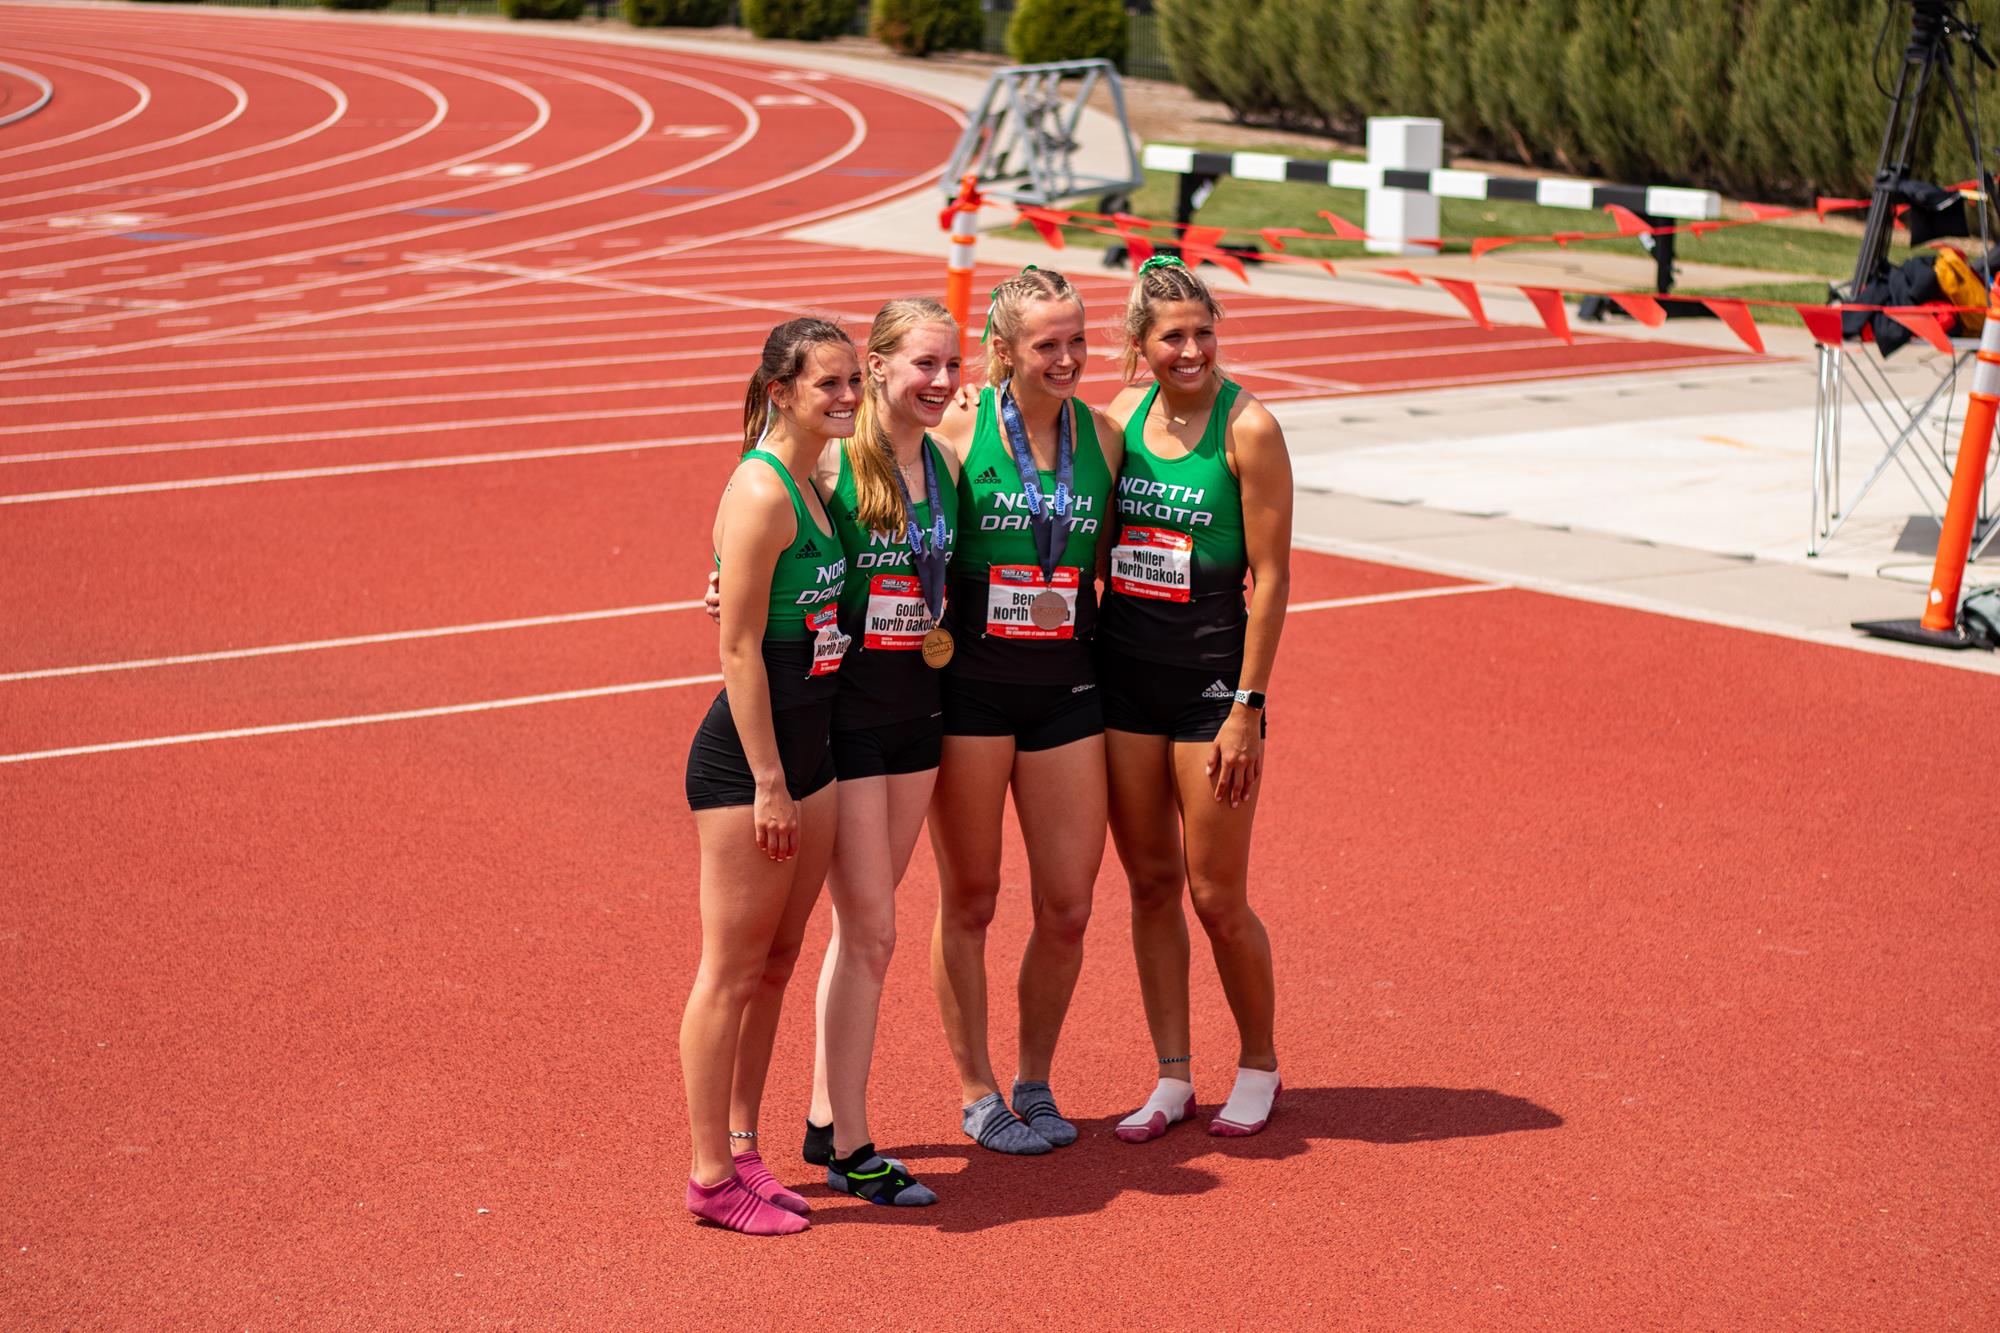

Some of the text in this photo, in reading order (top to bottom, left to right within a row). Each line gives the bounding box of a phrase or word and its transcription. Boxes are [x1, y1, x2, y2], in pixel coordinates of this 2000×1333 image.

[1118, 476, 1205, 505] NORTH
[993, 492, 1093, 513] NORH
[980, 515, 1098, 534] DATA
[869, 528, 954, 550] NOH
[856, 550, 953, 569] DAKA
[1132, 550, 1165, 567] Miller
[1117, 560, 1185, 585] North Dakota
[896, 603, 925, 618] Gould
[993, 606, 1028, 621] North
[871, 617, 904, 632] North
[1201, 689, 1235, 698] adidas
